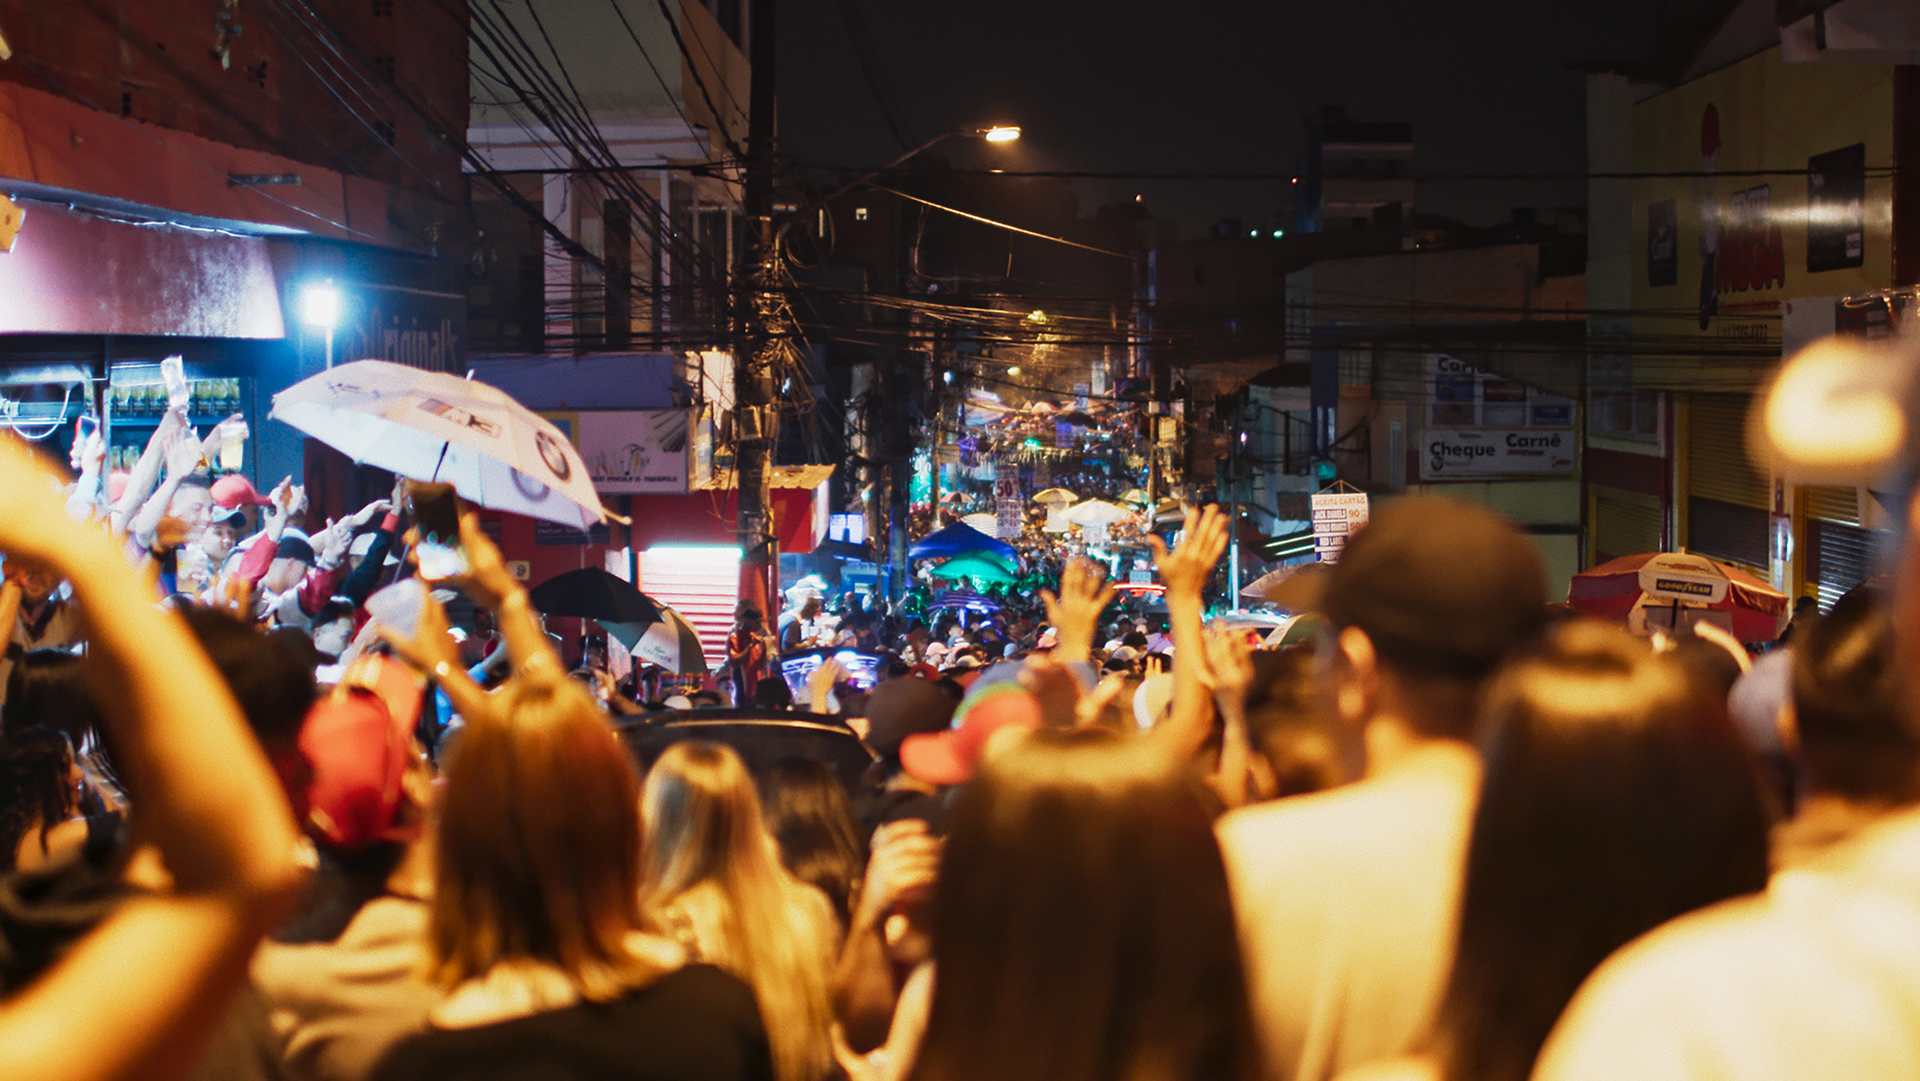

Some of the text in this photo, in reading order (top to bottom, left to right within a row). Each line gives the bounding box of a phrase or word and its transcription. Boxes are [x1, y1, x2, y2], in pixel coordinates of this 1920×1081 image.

[1506, 433, 1561, 448] Carnê
[1430, 441, 1496, 460] Cheque
[996, 480, 1013, 497] 50
[1348, 509, 1360, 518] 90
[1658, 580, 1711, 594] GOODYEAR
